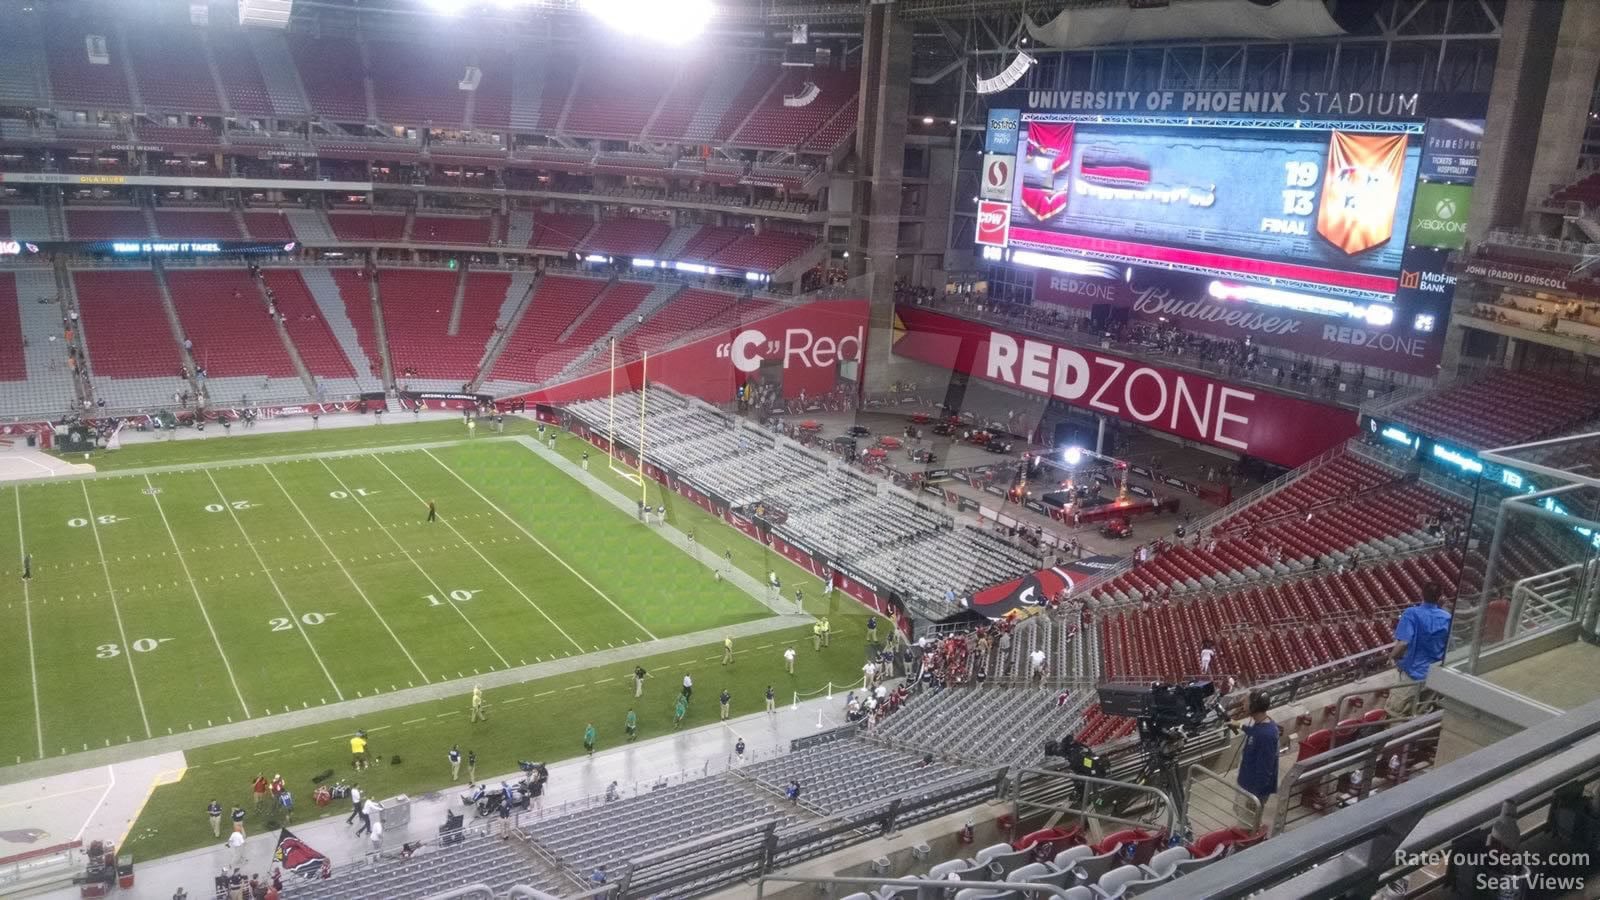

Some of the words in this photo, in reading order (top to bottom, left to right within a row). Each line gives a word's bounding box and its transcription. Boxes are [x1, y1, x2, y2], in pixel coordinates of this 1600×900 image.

[1028, 91, 1138, 110] UNIVERSITY
[1146, 92, 1174, 111] OF
[1182, 92, 1287, 113] PHOENIX
[1297, 92, 1419, 116] STADIUM
[1285, 161, 1318, 188] 19
[1282, 189, 1315, 216] 13
[1261, 217, 1309, 235] FINAL
[1417, 218, 1446, 231] XBOX
[142, 243, 152, 252] IS
[153, 243, 179, 252] WHAT
[181, 243, 189, 252] IT
[1050, 276, 1116, 301] REDZONE
[1419, 280, 1446, 293] BANK
[1465, 264, 1486, 276] JOHN
[1488, 268, 1523, 283] (PADDY)
[1524, 274, 1568, 290] DRISCOLL
[1130, 281, 1301, 336] Budweiser
[783, 326, 864, 369] Red
[1322, 324, 1427, 358] REDZONE
[986, 331, 1257, 450] REDZONE
[421, 590, 472, 607] 10
[268, 612, 326, 632] 20
[96, 638, 159, 659] 30
